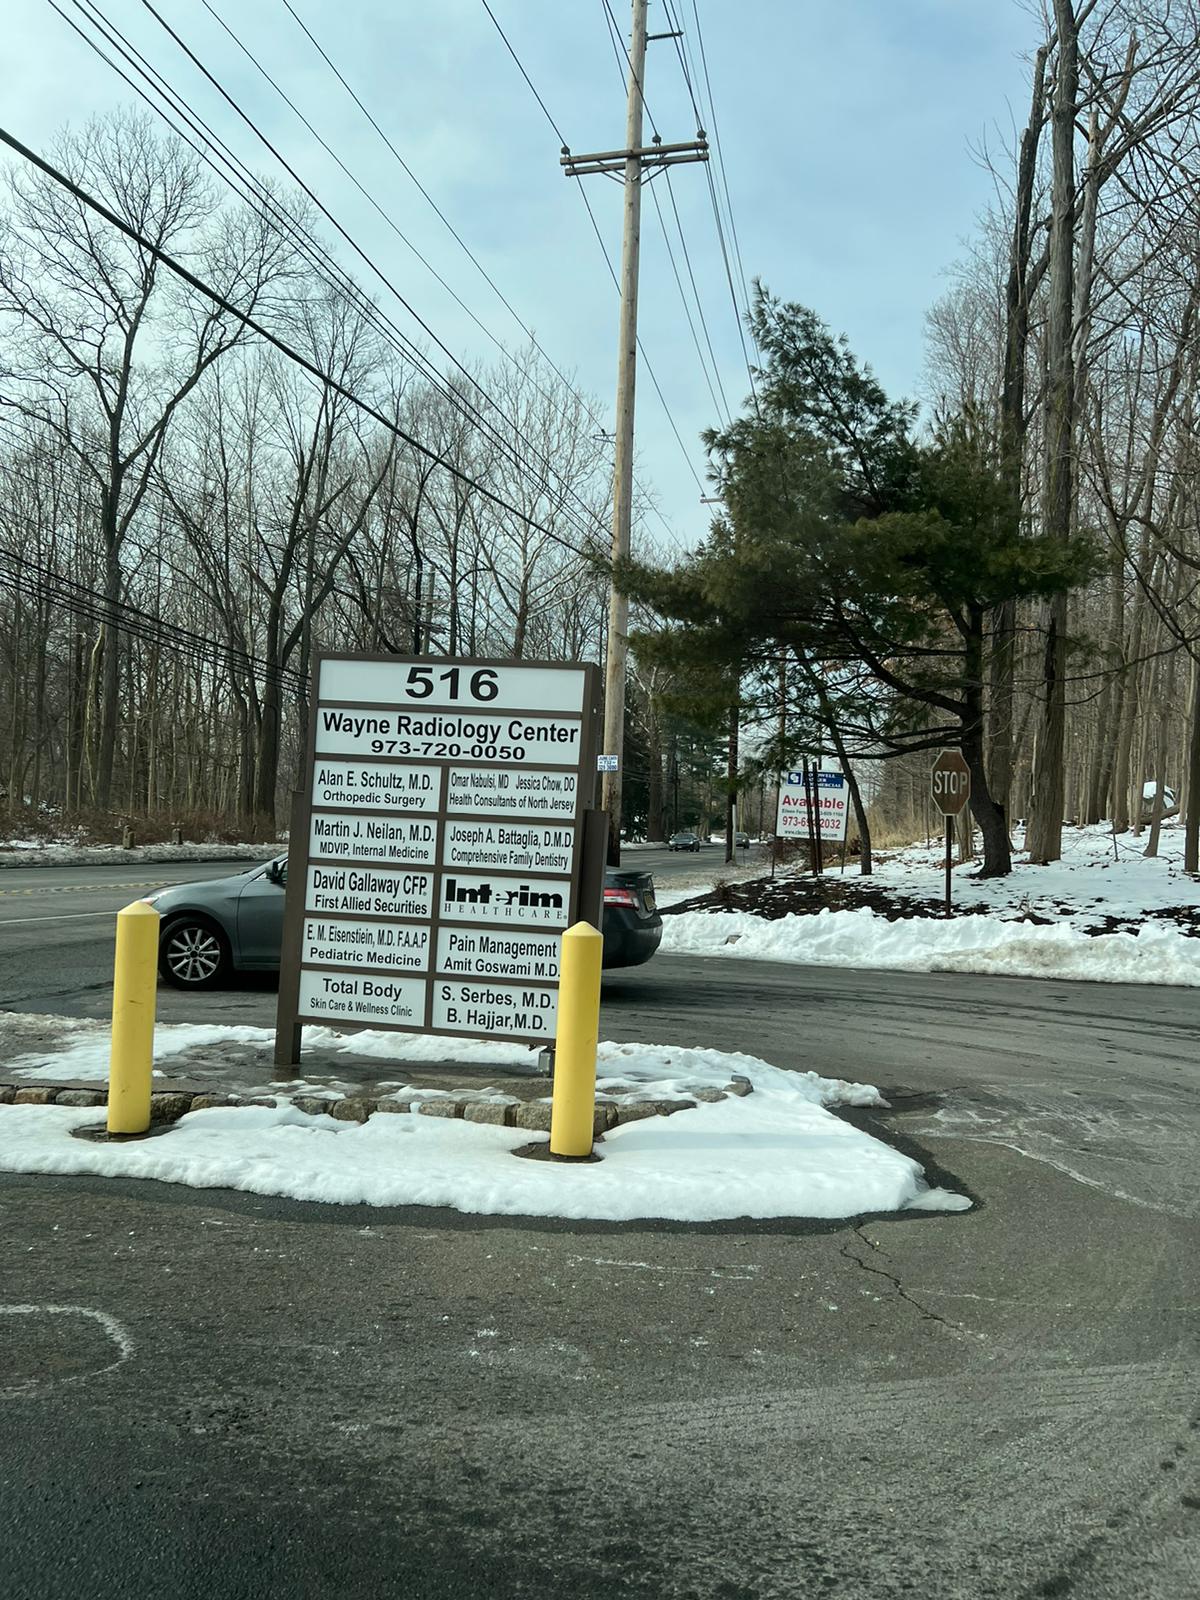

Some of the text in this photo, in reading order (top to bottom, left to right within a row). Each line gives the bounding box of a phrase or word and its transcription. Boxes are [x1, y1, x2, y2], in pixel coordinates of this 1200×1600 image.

[405, 666, 499, 701] 516
[323, 712, 578, 744] Wayne Radiology Center
[371, 740, 526, 760] 973-720-0050
[318, 769, 433, 792] Alan E. Schultz, M.D.
[451, 772, 469, 787] Omar
[498, 773, 509, 789] MD
[516, 775, 575, 794] Jessica Chow, DO
[934, 770, 968, 794] STOP
[323, 789, 426, 808] Orthopedic Surgery
[449, 792, 574, 813] Health Consultants of North Jersey
[782, 794, 844, 809] Avaable
[314, 819, 435, 842] Martin J. Neilan, M.D.
[782, 816, 841, 829] 973-62032
[450, 826, 574, 849] Joseph A. Battaglia, D.M.D.
[320, 841, 429, 859] MDVIP, Internal Medicine
[451, 847, 568, 871] Comprehensive Family Dentistry
[313, 869, 346, 890] David
[349, 872, 400, 899] Gallaway
[445, 878, 563, 908] Interim
[315, 894, 428, 915] First Allied Securities
[307, 924, 315, 940] E.
[317, 924, 327, 941] M.
[377, 929, 395, 946] M.D.
[310, 946, 421, 967] Pediatric Medicine
[449, 934, 557, 959] Pain Management
[443, 956, 560, 977] Amit Goswami M.D.
[323, 978, 402, 1002] Total Body
[441, 985, 555, 1009] S. Serbes, M.D.
[310, 997, 413, 1017] Skin Care & Wellness Clinic
[447, 1007, 461, 1023] B.
